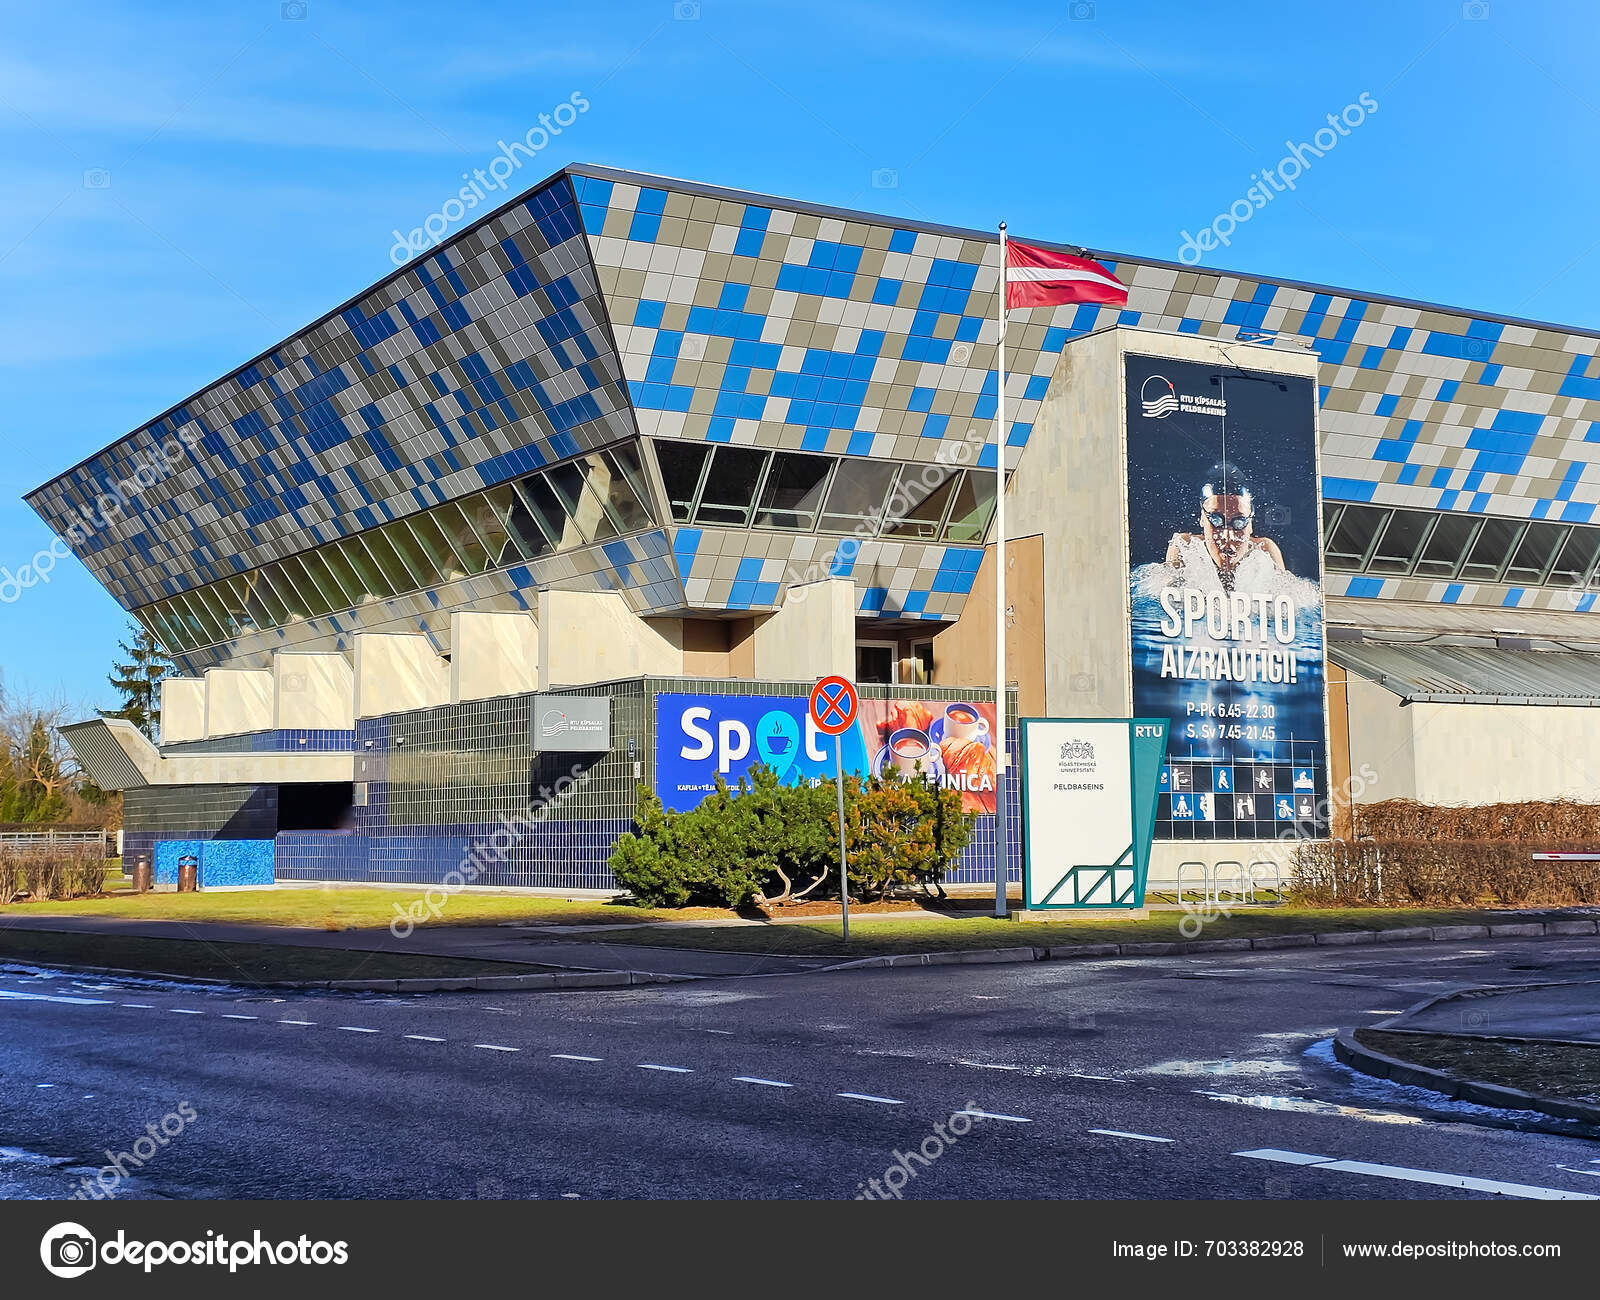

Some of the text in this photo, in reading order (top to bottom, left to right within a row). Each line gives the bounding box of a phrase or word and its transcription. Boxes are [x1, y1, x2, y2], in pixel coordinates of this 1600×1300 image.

[1180, 395, 1194, 404] RTU
[1180, 404, 1227, 416] PELDBASEINS
[1160, 586, 1297, 644] SPORTO
[1160, 643, 1298, 685] AIZRAUTĪGI!
[1186, 702, 1275, 719] P-Pk 6.45-22.30
[1135, 725, 1163, 738] RTU
[1201, 724, 1217, 738] Sv
[1218, 725, 1276, 740] 7.45-21.45
[1053, 783, 1104, 791] PELDBASEINS
